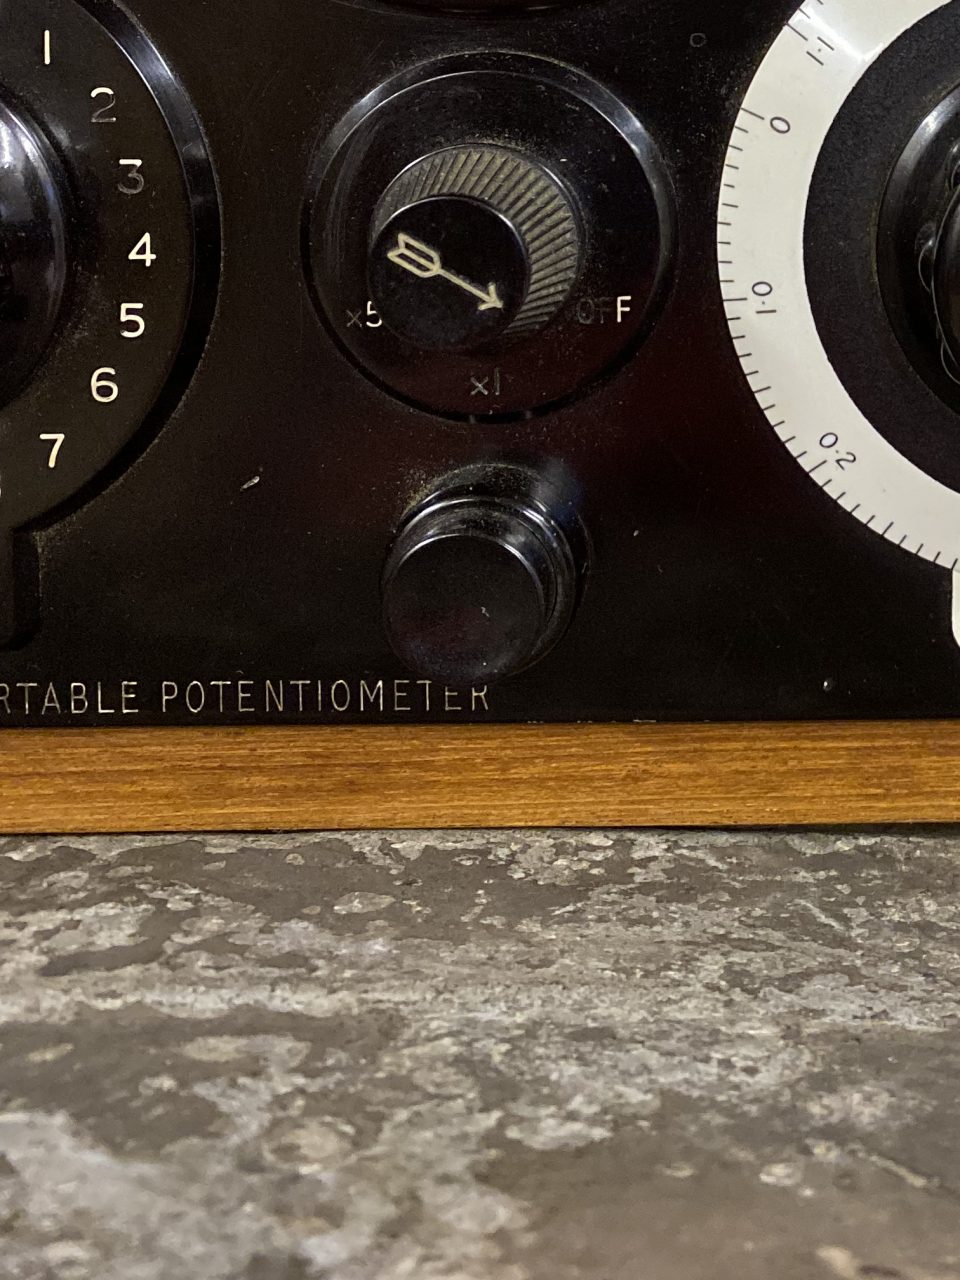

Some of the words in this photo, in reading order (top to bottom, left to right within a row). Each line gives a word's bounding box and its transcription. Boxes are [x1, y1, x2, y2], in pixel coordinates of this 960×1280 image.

[43, 29, 51, 65] 1
[90, 86, 117, 123] 2
[769, 116, 791, 134] 0
[117, 158, 145, 195] 3
[127, 231, 157, 267] 4
[119, 302, 146, 338] 5
[90, 366, 119, 403] 6
[39, 433, 65, 468] 7
[161, 678, 490, 713] POTENTIOMETER
